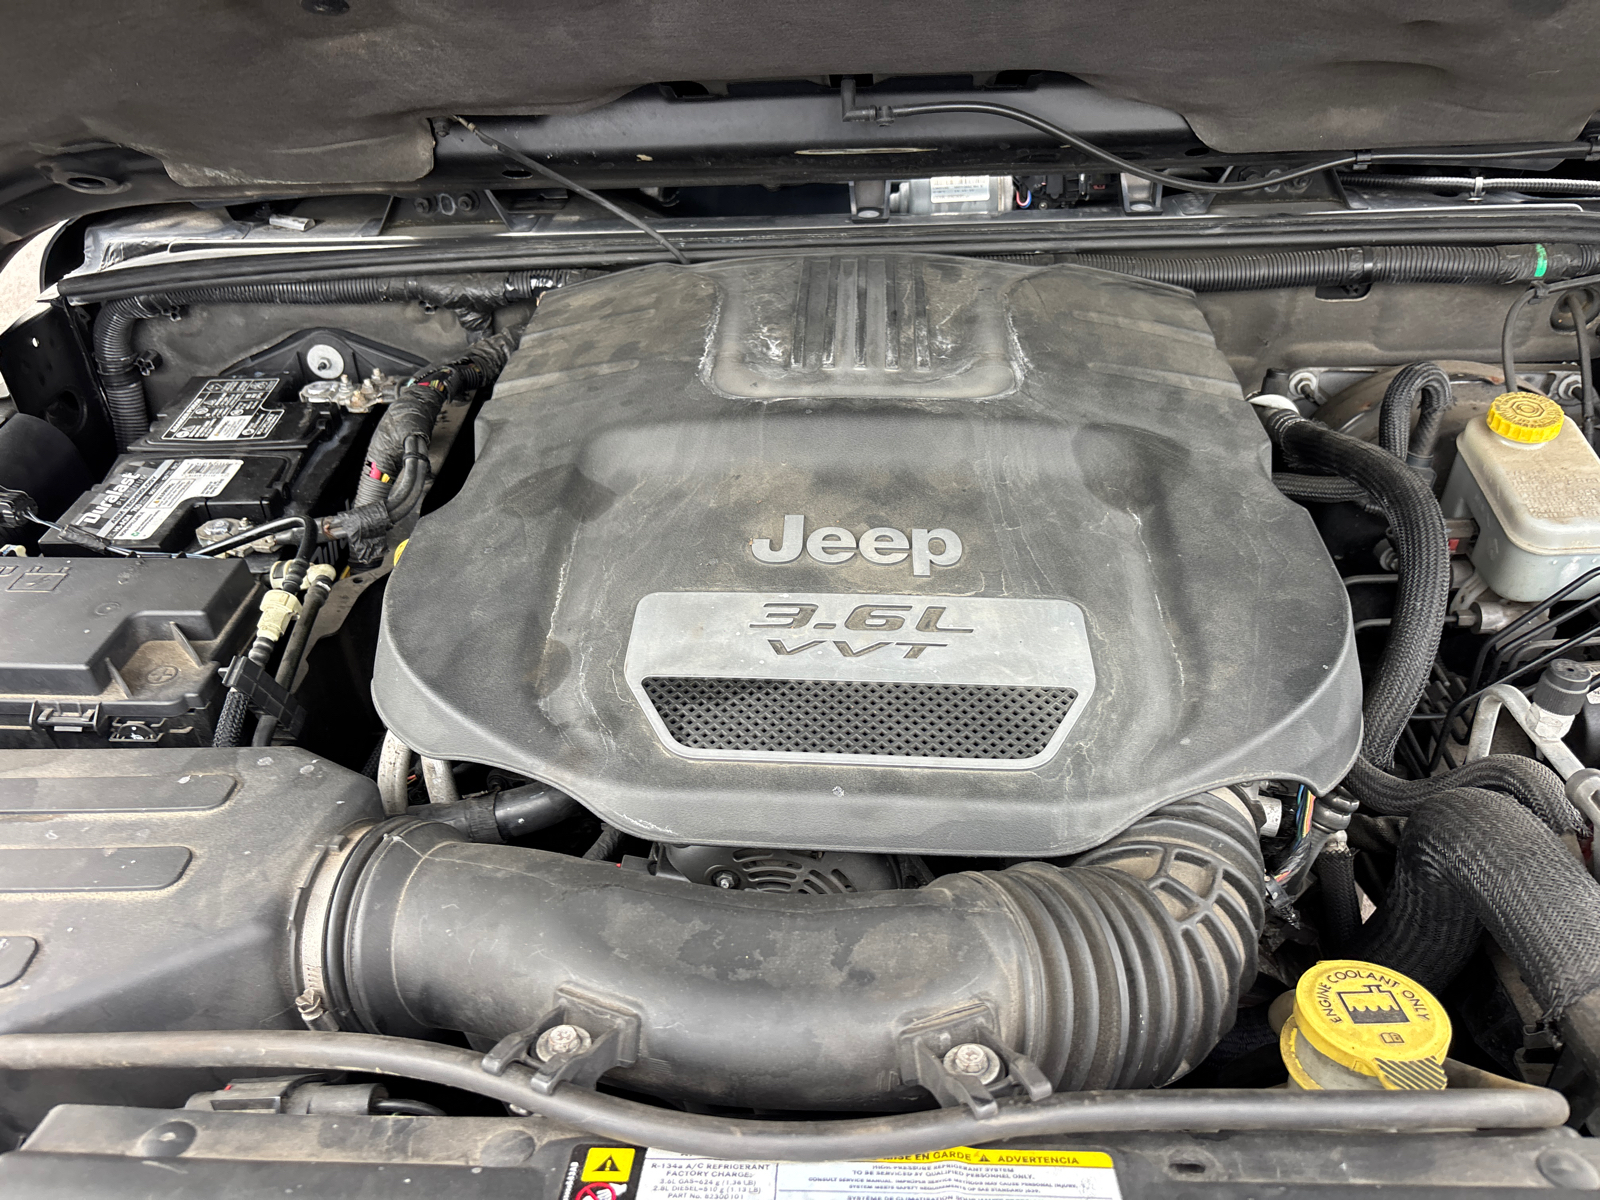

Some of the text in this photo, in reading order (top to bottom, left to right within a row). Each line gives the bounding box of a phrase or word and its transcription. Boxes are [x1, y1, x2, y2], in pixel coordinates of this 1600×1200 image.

[75, 472, 141, 525] Duralast
[115, 474, 148, 506] PLATINUM
[123, 475, 157, 510] TECHNOLOGY
[750, 514, 963, 577] Jeep
[749, 602, 974, 634] 3.6L
[767, 638, 948, 659] VVT
[1316, 969, 1431, 1024] ENGINE COOLANT ONLY
[685, 1162, 704, 1170] A/C
[915, 1153, 930, 1161] EN
[933, 1151, 971, 1162] GARDE
[998, 1155, 1080, 1165] ADVERTENCIA
[933, 1163, 983, 1172] REFRIGERANT
[743, 1179, 757, 1187] LB)
[926, 1169, 964, 1177] QUALIFIED
